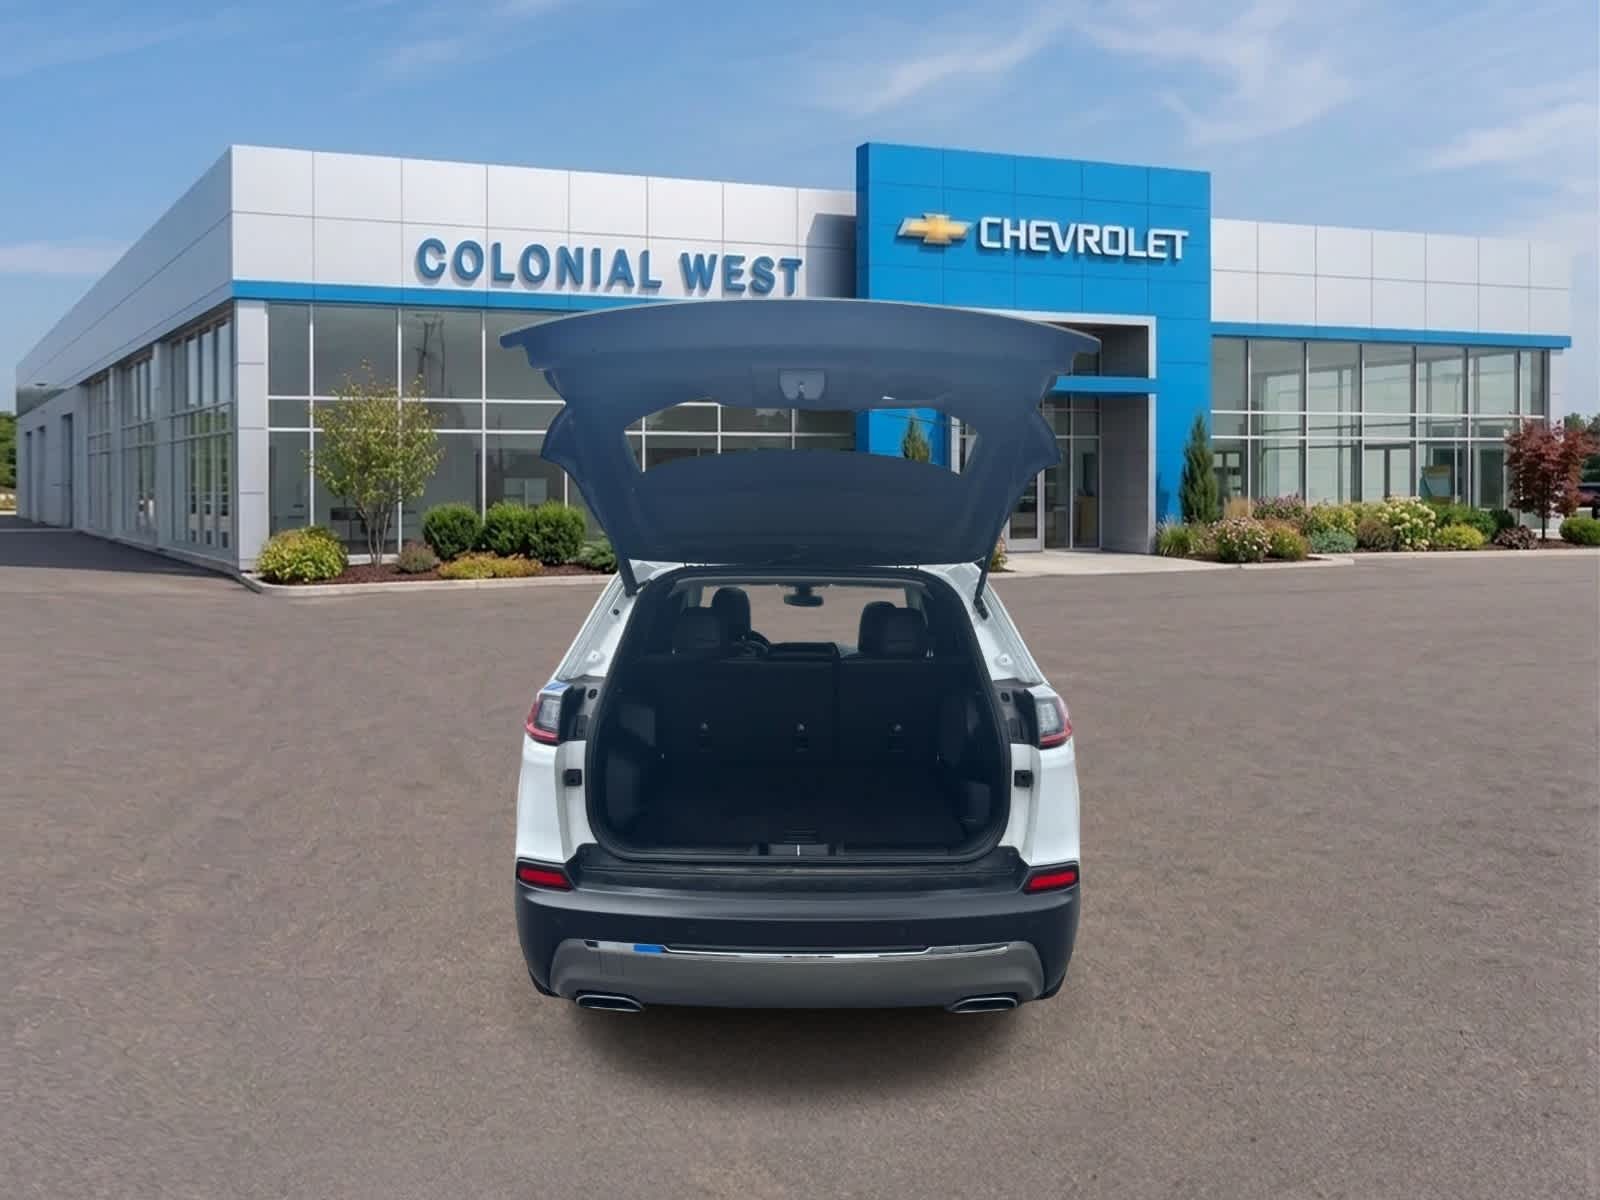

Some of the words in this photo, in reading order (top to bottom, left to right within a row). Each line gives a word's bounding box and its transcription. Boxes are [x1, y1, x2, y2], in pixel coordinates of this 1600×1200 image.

[979, 216, 1190, 260] CHEVROLET
[416, 238, 662, 289] COLONIAL
[680, 252, 803, 295] WEST
